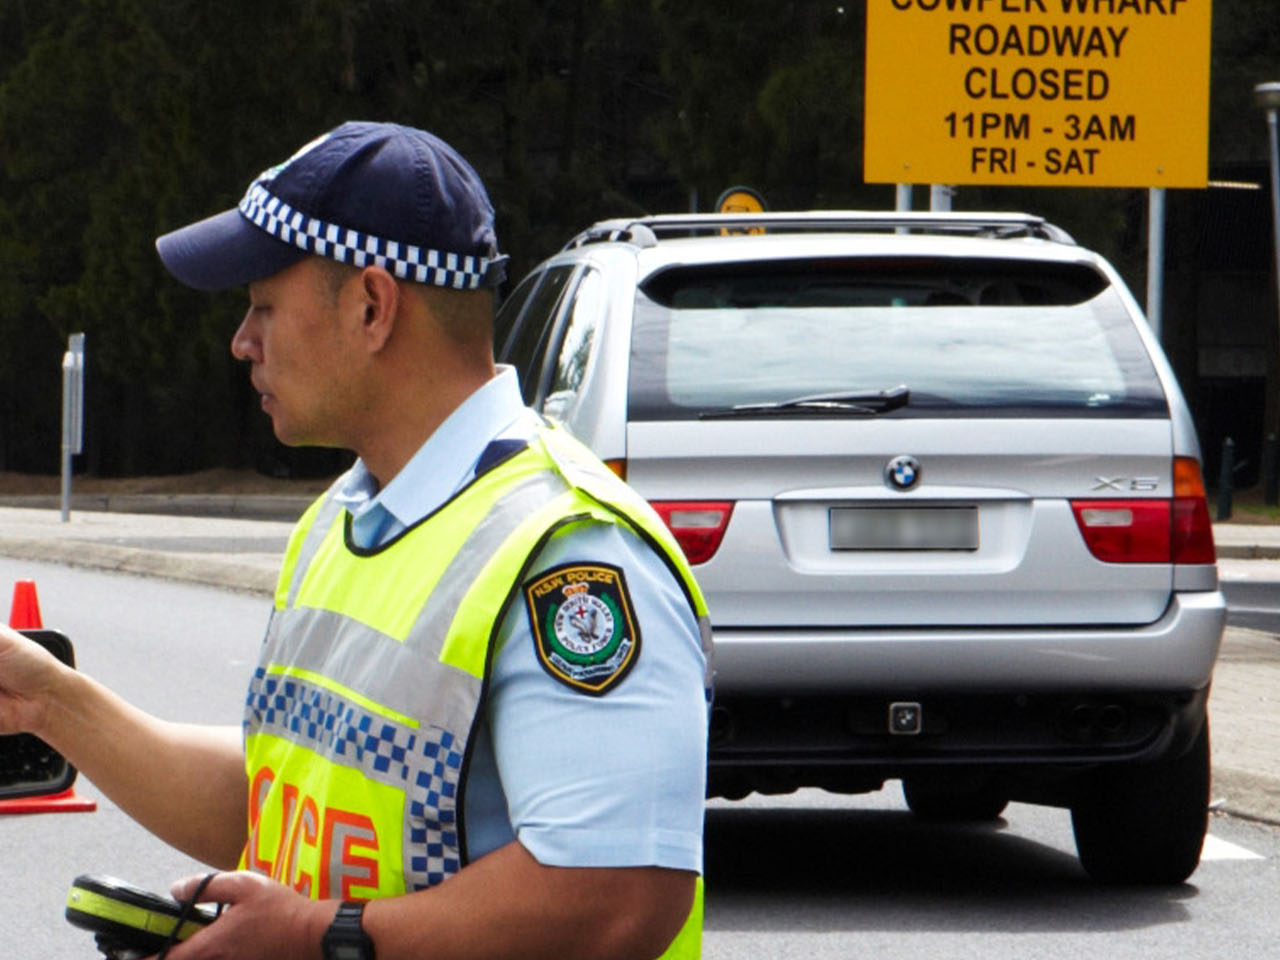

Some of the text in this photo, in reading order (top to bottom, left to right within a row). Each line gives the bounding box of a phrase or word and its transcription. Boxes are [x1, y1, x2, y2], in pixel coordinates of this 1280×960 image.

[949, 23, 1129, 58] ROADWAY
[964, 66, 1110, 101] CLOSED
[945, 112, 1030, 140] 11PM
[1064, 114, 1136, 141] 3AM
[971, 147, 1016, 174] FRI
[1044, 147, 1100, 175] SAT
[1091, 476, 1160, 491] X5
[567, 572, 614, 585] POLICE
